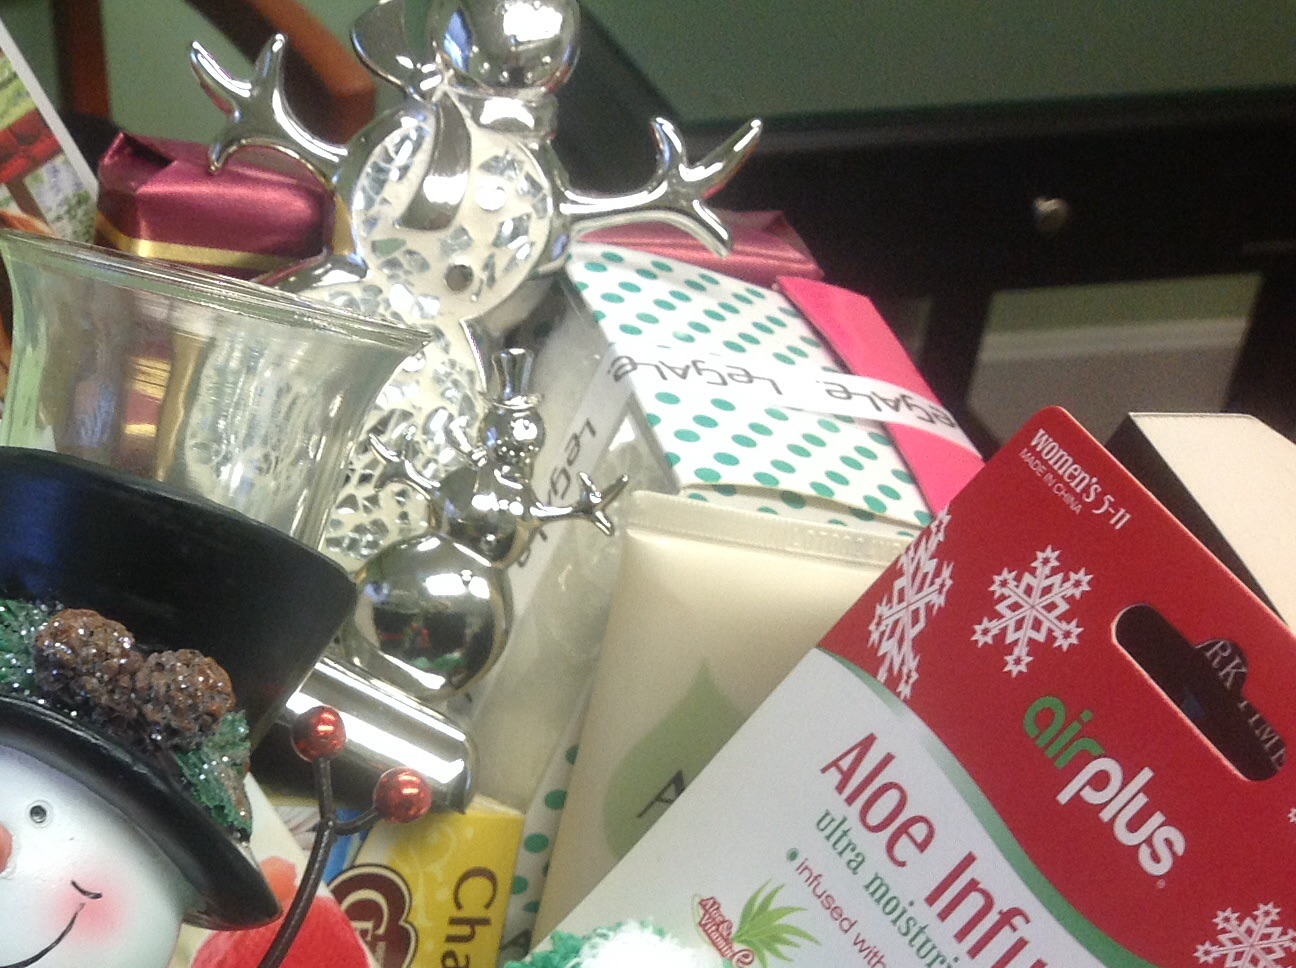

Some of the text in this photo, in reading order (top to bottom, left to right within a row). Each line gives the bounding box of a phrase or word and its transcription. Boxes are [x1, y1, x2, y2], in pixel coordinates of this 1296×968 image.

[1019, 448, 1082, 514] MADE IN CHINA
[1092, 495, 1131, 529] 5-11
[820, 733, 935, 868] Aloe
[815, 809, 865, 875] ultra
[699, 897, 724, 923] Aloe
[795, 858, 858, 934] infused
[698, 914, 735, 957] Vitamin
